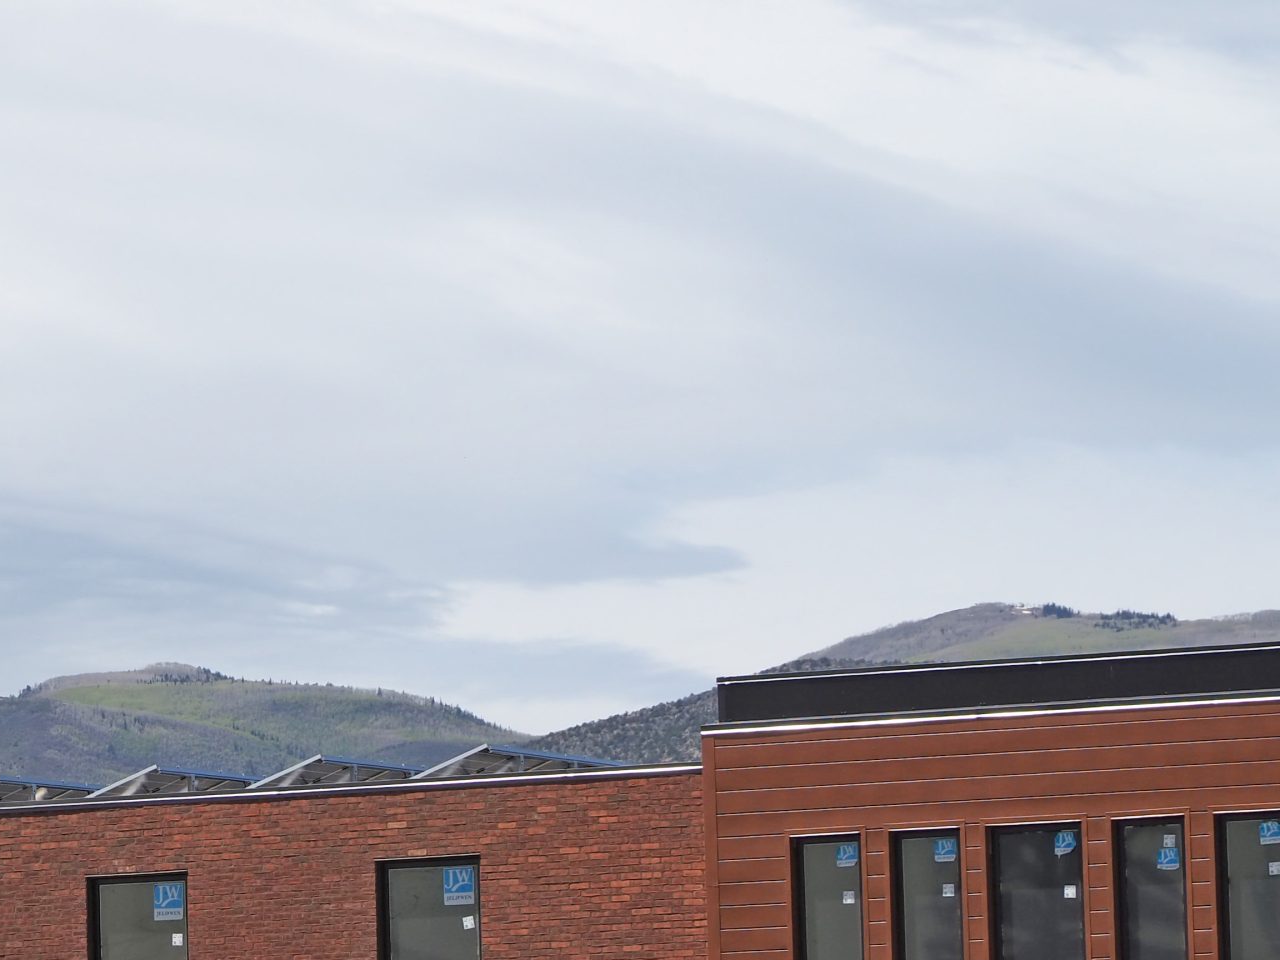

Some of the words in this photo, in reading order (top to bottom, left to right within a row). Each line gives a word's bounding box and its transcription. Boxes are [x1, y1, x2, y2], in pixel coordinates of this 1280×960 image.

[837, 845, 856, 857] JW
[936, 840, 955, 853] JW
[1158, 848, 1178, 861] JW
[445, 868, 472, 888] JW
[154, 885, 180, 905] JW
